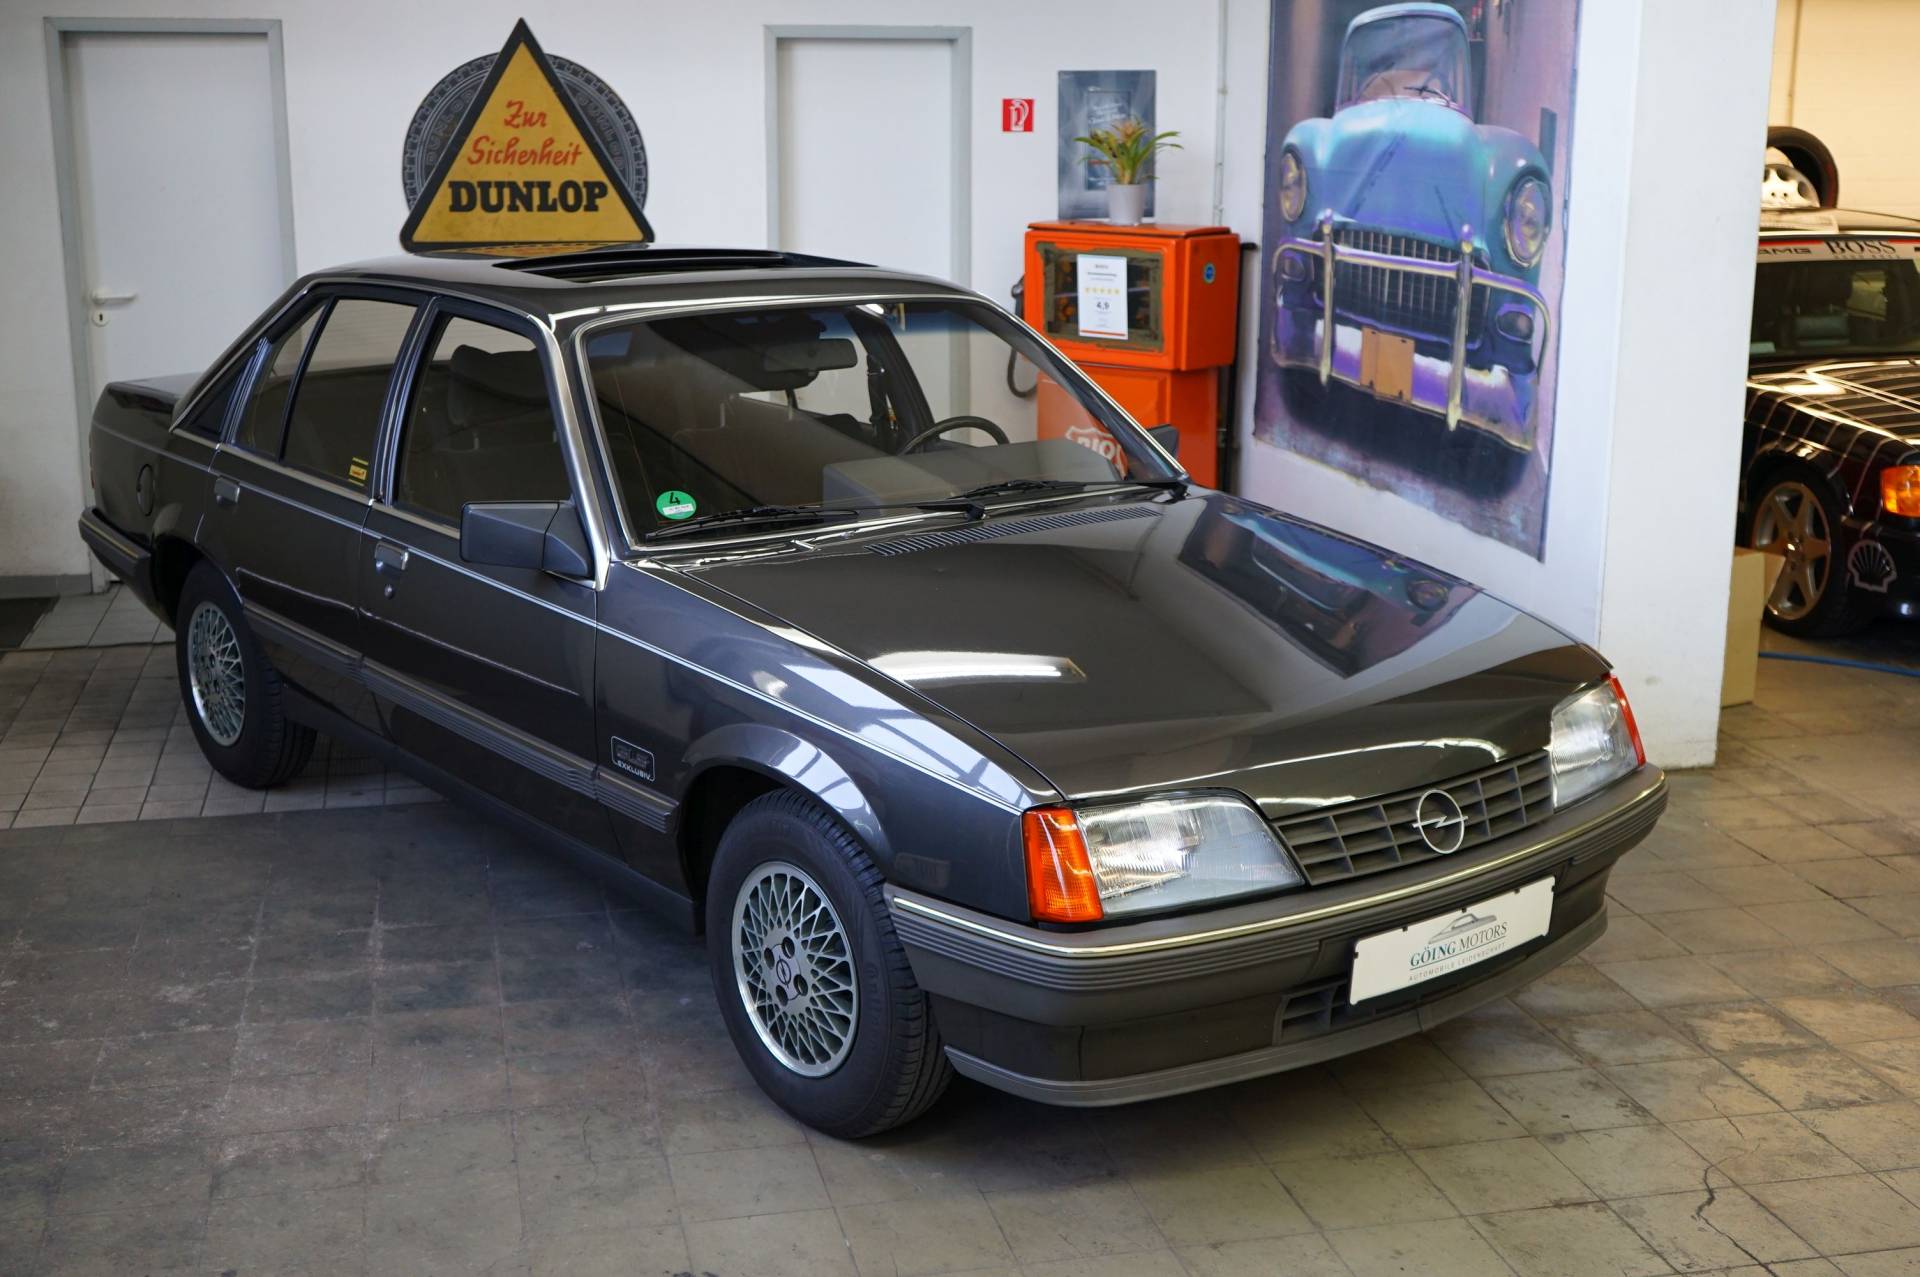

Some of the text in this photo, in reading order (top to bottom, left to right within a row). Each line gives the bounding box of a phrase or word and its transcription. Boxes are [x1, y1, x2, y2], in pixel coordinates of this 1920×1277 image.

[503, 100, 547, 128] Zur
[467, 135, 582, 165] Sicherheit
[448, 180, 609, 213] DUNLOP
[1825, 240, 1896, 254] BOSS
[669, 492, 681, 505] 4
[1410, 921, 1508, 967] GÖING MOTORS
